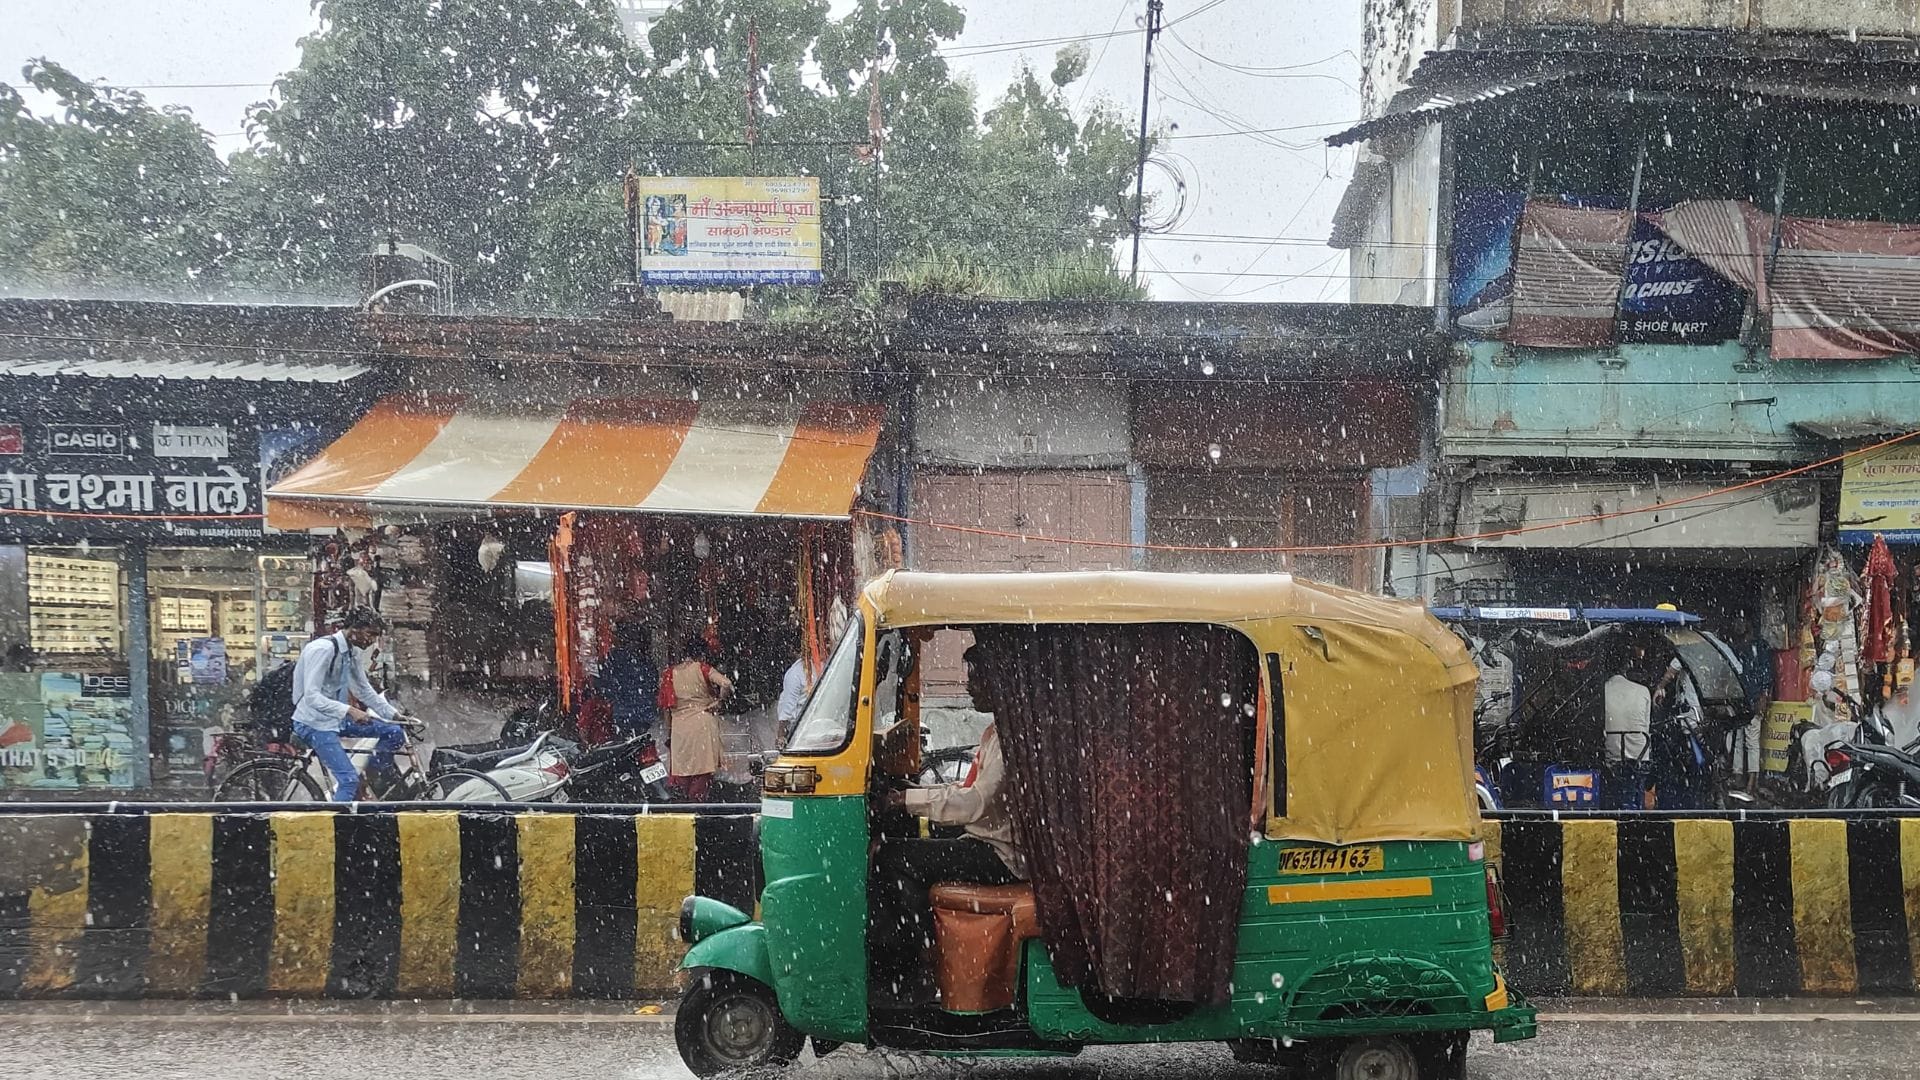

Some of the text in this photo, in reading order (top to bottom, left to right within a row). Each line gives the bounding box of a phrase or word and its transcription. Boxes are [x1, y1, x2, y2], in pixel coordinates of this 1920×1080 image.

[691, 196, 815, 224] माँ अन्नपूर्णा पूजा
[707, 224, 749, 237] सामग्री
[1637, 281, 1696, 298] CHASE
[1671, 322, 1708, 332] MART
[54, 433, 117, 448] CASIO
[178, 433, 224, 448] TITAN
[45, 472, 156, 512] चश्मा
[163, 465, 250, 514] वाले
[1533, 610, 1568, 619] INSURED
[645, 768, 666, 782] 1339
